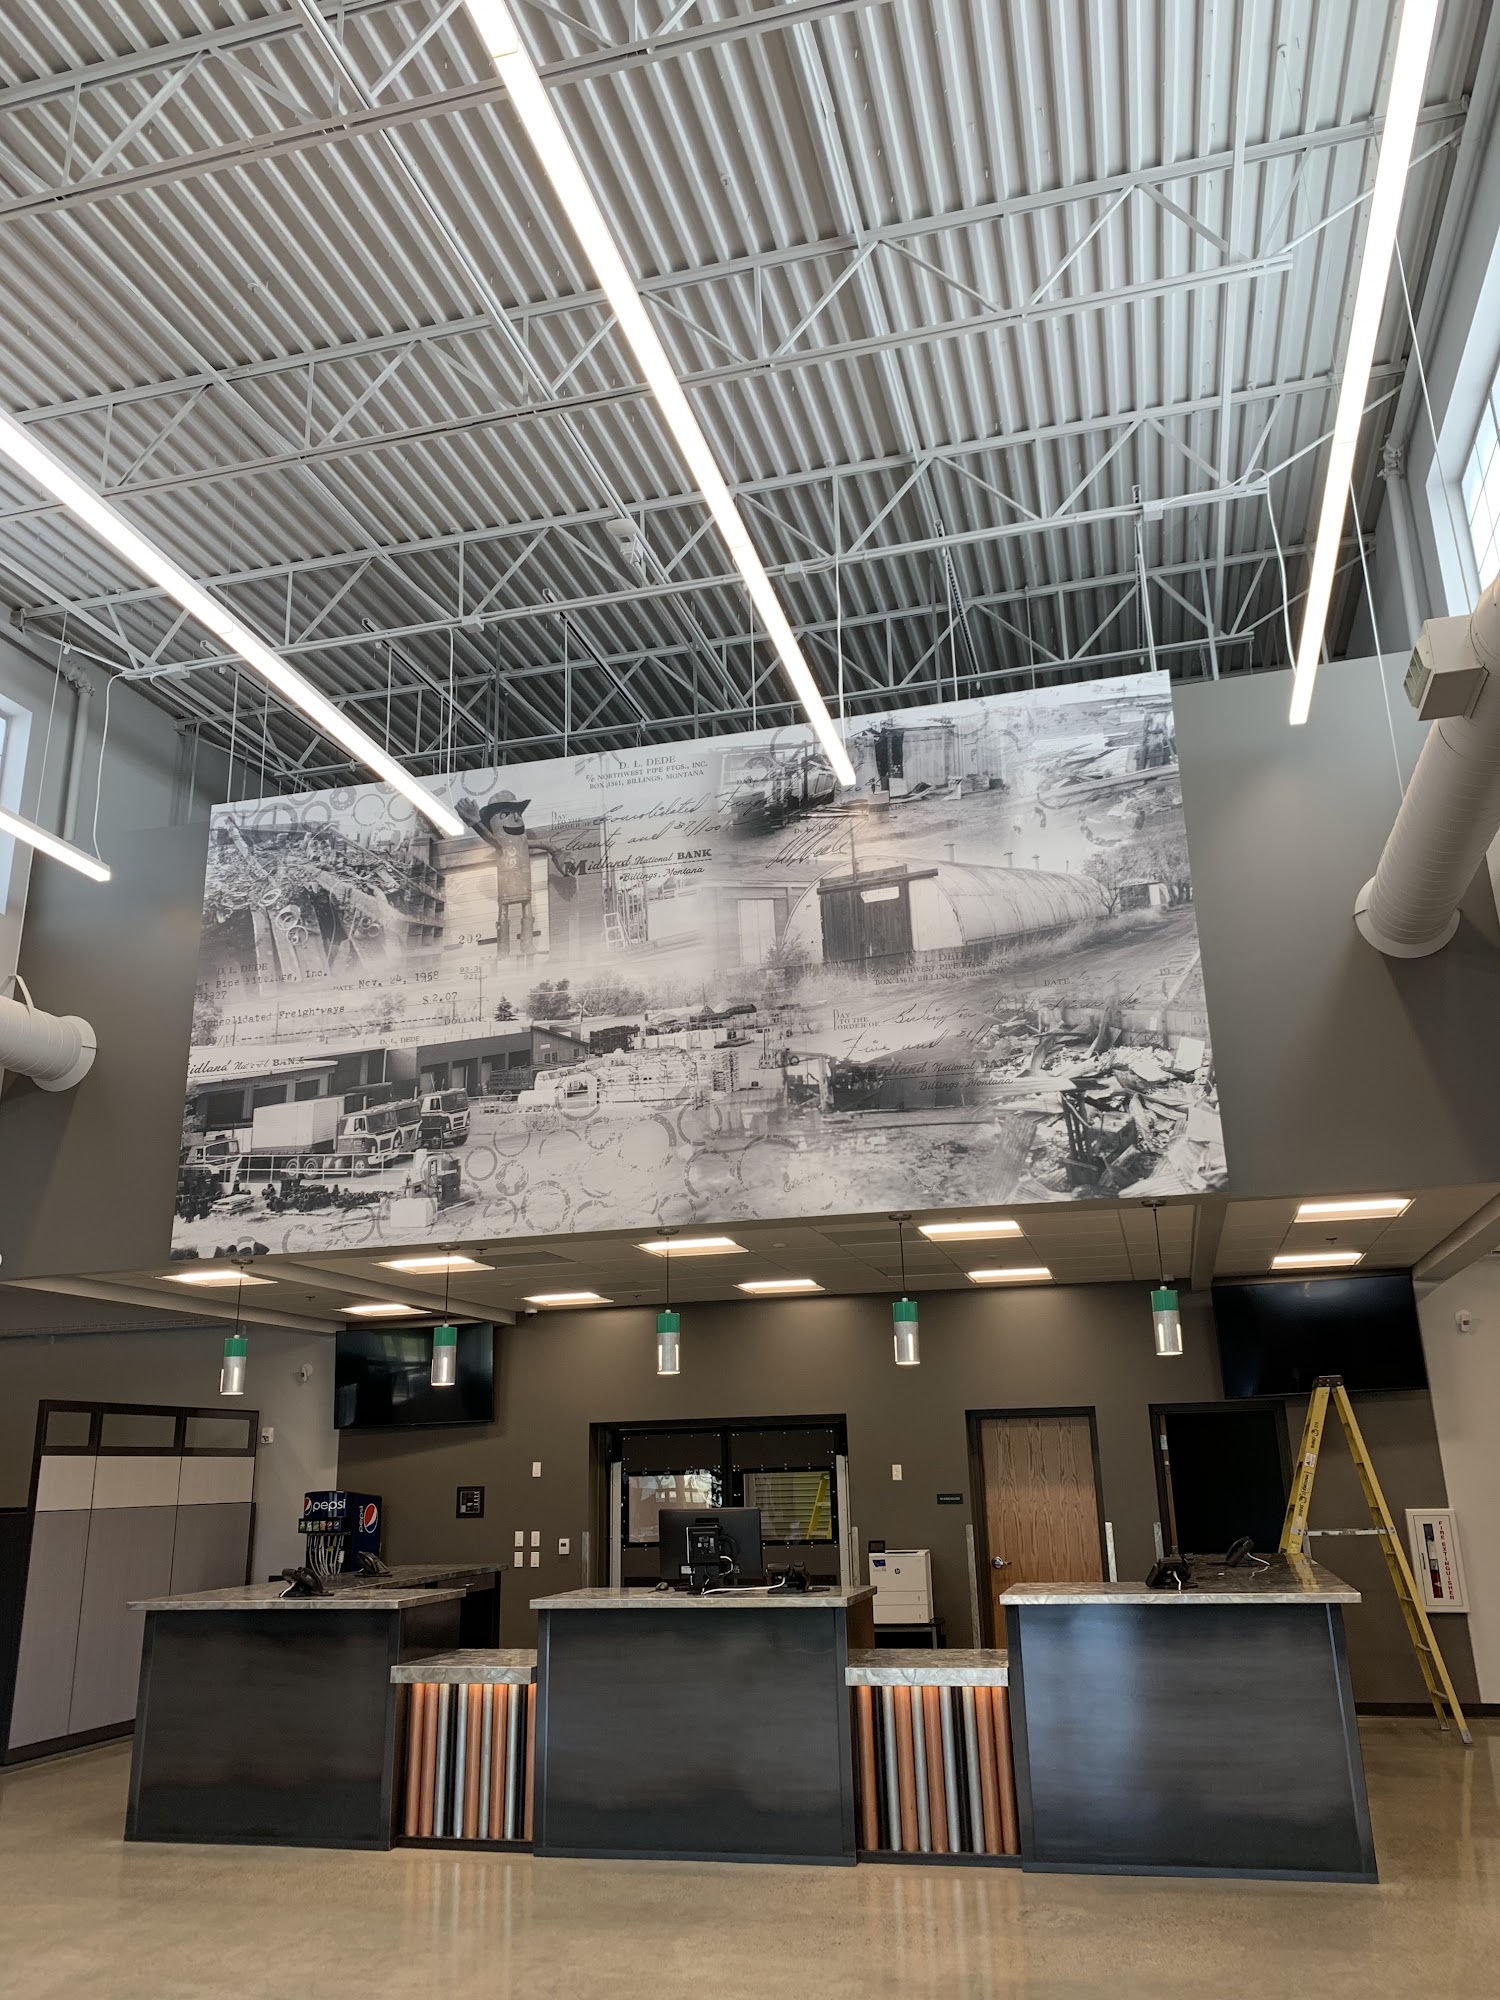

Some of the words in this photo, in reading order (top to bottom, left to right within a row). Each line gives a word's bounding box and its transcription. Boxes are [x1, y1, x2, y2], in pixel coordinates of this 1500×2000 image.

[619, 761, 630, 770] D.
[634, 759, 643, 768] L.
[646, 755, 676, 766] DEDE
[597, 768, 644, 781] NORTHWEST
[646, 765, 664, 775] PIPE
[692, 760, 708, 769] INC.
[589, 782, 605, 790] BOX
[626, 775, 663, 785] BILLINGS,
[665, 770, 704, 780] MONTANA
[554, 821, 582, 831] ORDER
[564, 854, 632, 877] Midland
[635, 852, 673, 865] National
[677, 848, 712, 860] BANK
[663, 867, 705, 878] Montana
[458, 934, 482, 945] 202
[938, 951, 972, 962] DEDE
[241, 963, 268, 973] DEDE
[884, 964, 936, 977] NORTHWEST
[939, 962, 959, 971] PIPE
[215, 979, 240, 989] Pipe
[305, 970, 328, 979] Inc.
[875, 978, 892, 986] BOX
[917, 972, 959, 982] BILLINGS,
[1044, 977, 1070, 986] DATE
[201, 1012, 272, 1028] Consolidated
[837, 1021, 867, 1030] ORDER
[400, 1036, 420, 1044] DEDE
[188, 1060, 232, 1075] idland
[932, 1059, 975, 1073] National
[964, 1077, 1013, 1088] Montana
[313, 1499, 346, 1512] pepsi
